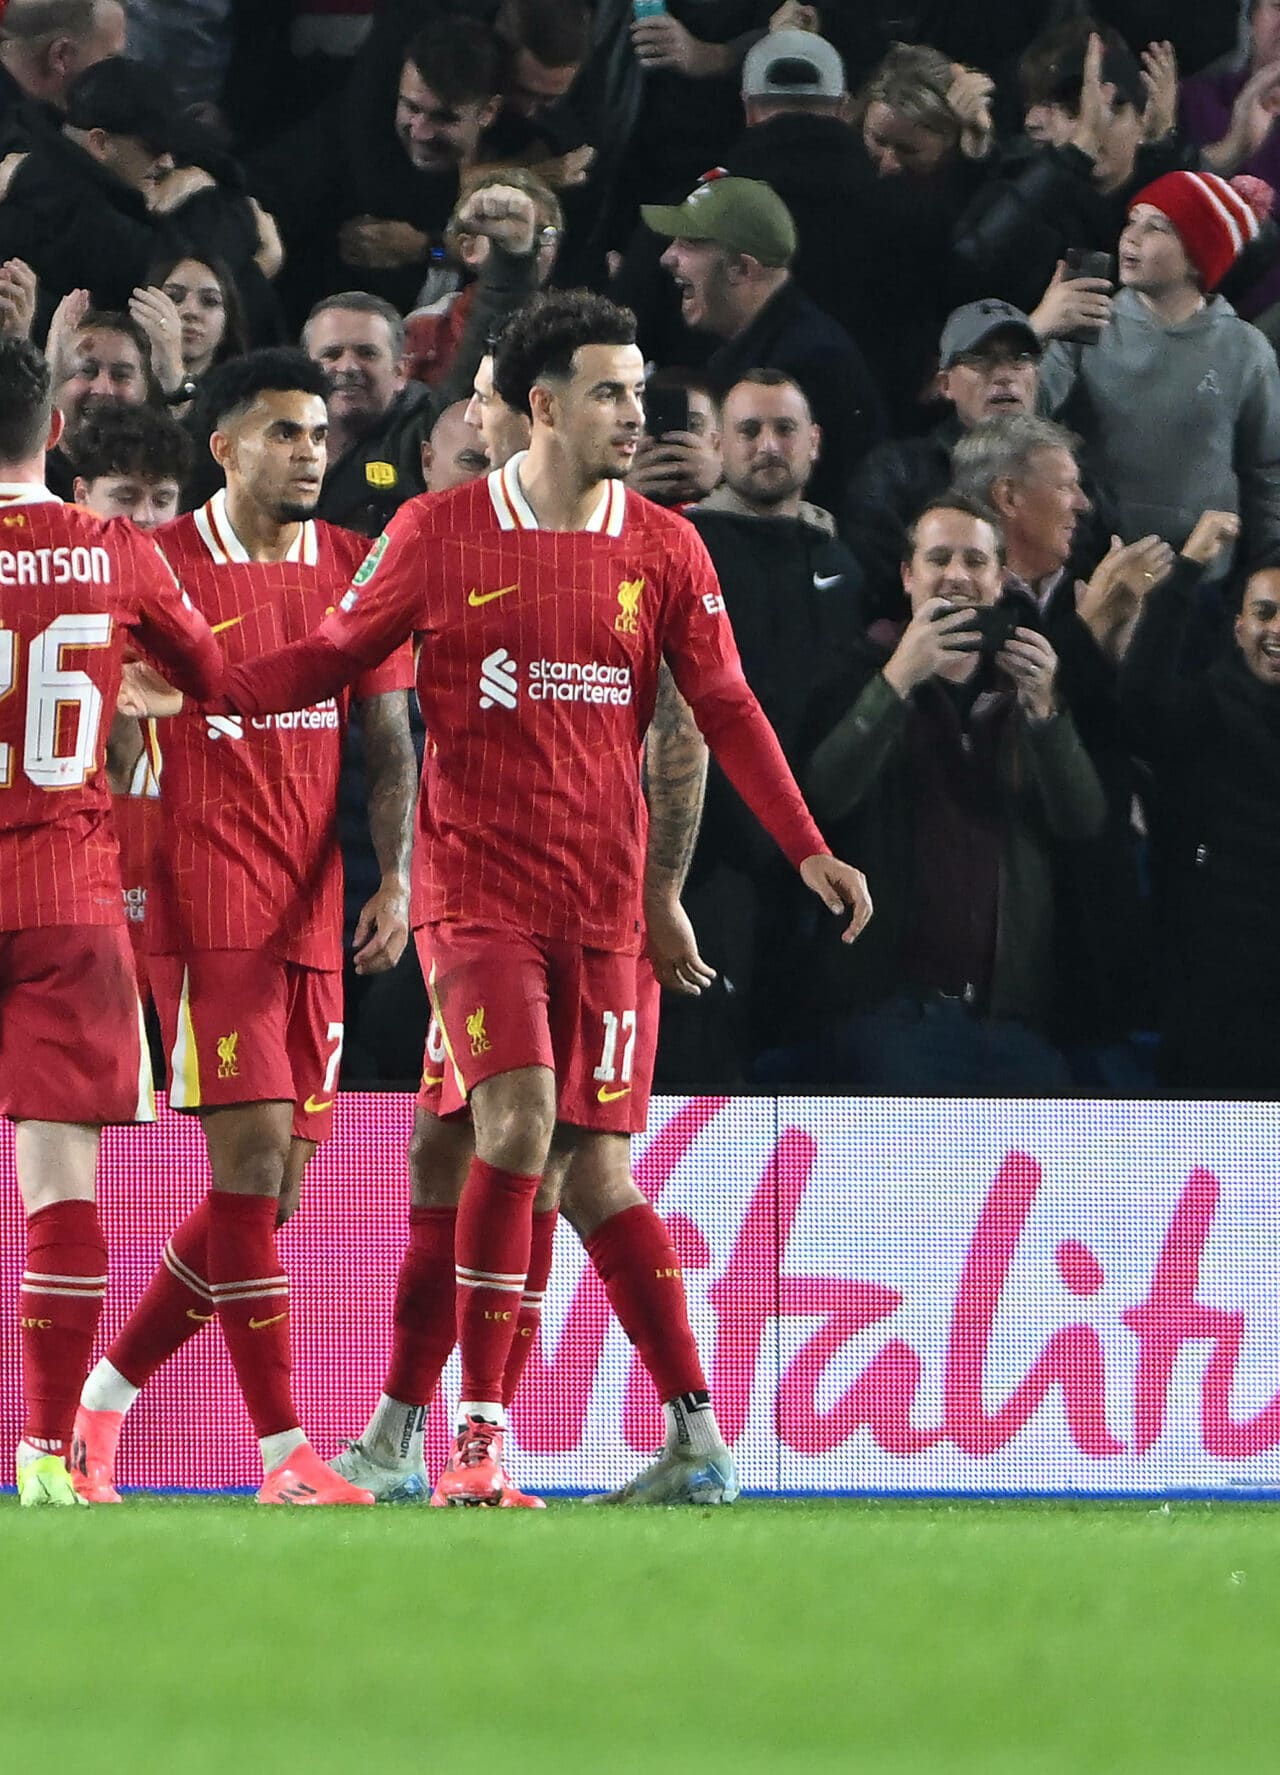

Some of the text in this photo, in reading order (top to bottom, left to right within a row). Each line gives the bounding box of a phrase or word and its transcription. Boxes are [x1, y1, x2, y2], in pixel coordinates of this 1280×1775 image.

[528, 658, 630, 685] standard
[528, 679, 632, 706] chartered
[593, 1010, 637, 1083] 17
